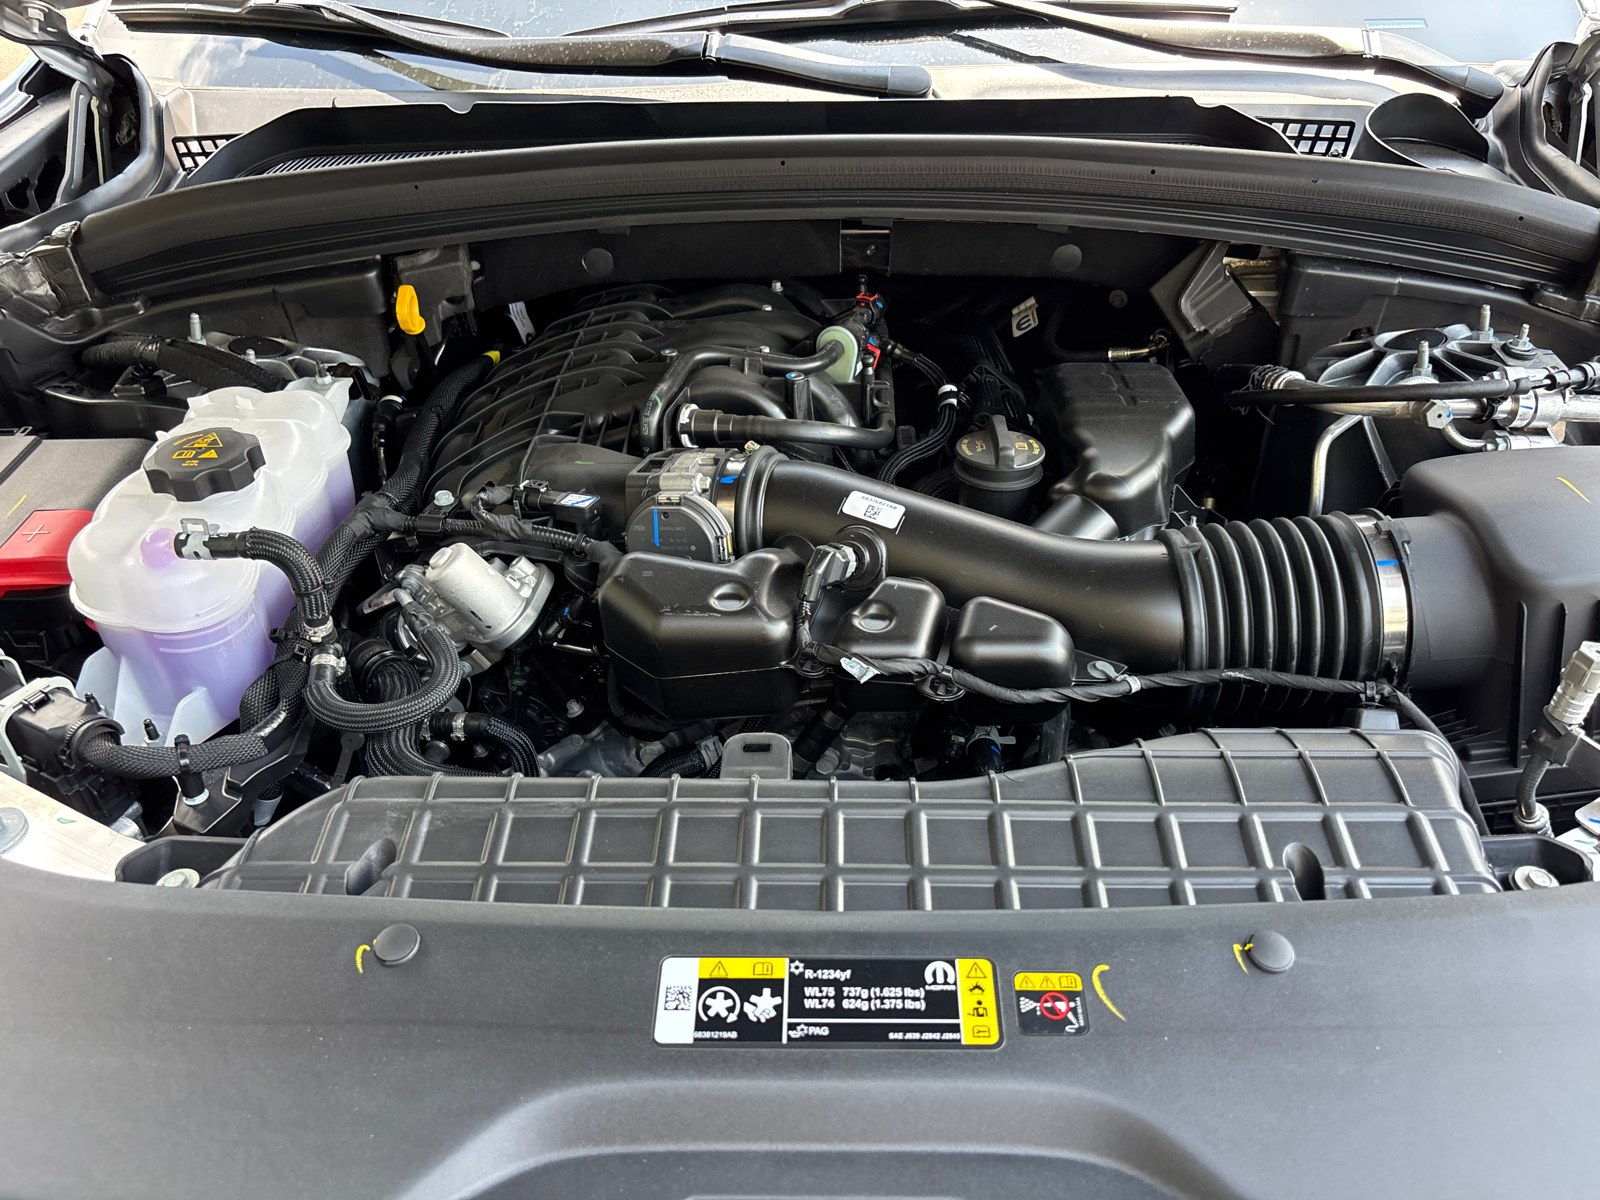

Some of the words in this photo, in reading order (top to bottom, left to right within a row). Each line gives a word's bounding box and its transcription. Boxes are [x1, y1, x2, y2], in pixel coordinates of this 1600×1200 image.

[804, 969, 852, 981] R-1234yf
[804, 987, 836, 998] WL75
[842, 987, 870, 999] 737g
[870, 987, 903, 999] (1.625
[904, 987, 926, 999] lbs)
[804, 999, 836, 1009] WL74
[842, 999, 870, 1012] 624g
[871, 999, 904, 1011] (1.375
[905, 999, 927, 1011] lbs)
[808, 1026, 830, 1036] PAG
